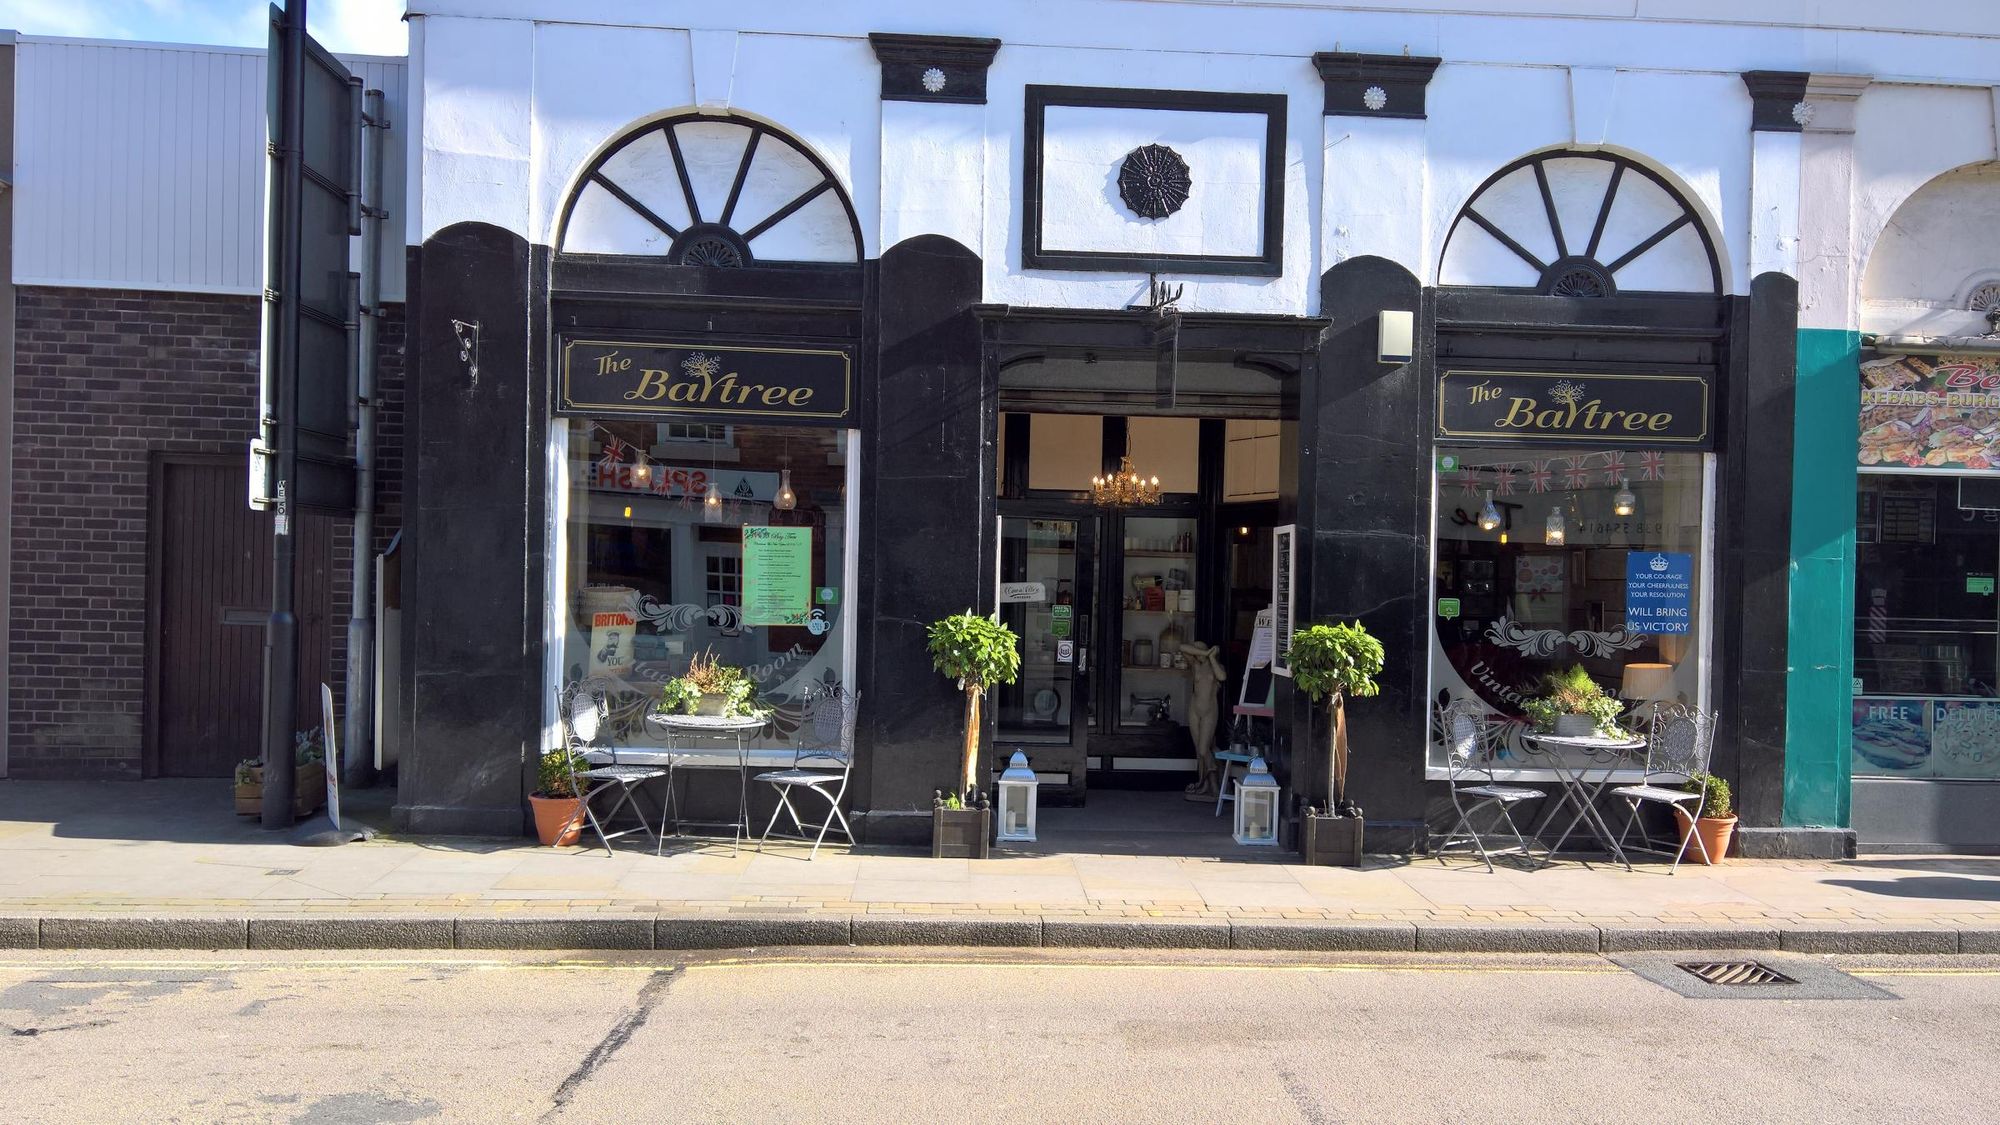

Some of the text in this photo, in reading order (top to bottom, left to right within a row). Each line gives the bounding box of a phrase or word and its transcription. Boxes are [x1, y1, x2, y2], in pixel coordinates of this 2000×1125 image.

[594, 350, 632, 376] The
[1466, 379, 1503, 405] The
[1646, 582, 1689, 590] CHEERFULNESS
[1649, 591, 1686, 599] RESOLUTION
[1628, 607, 1688, 617] WILL BRING
[1627, 621, 1689, 632] US VICTORY
[746, 642, 802, 683] Room
[1869, 706, 1909, 720] FREE
